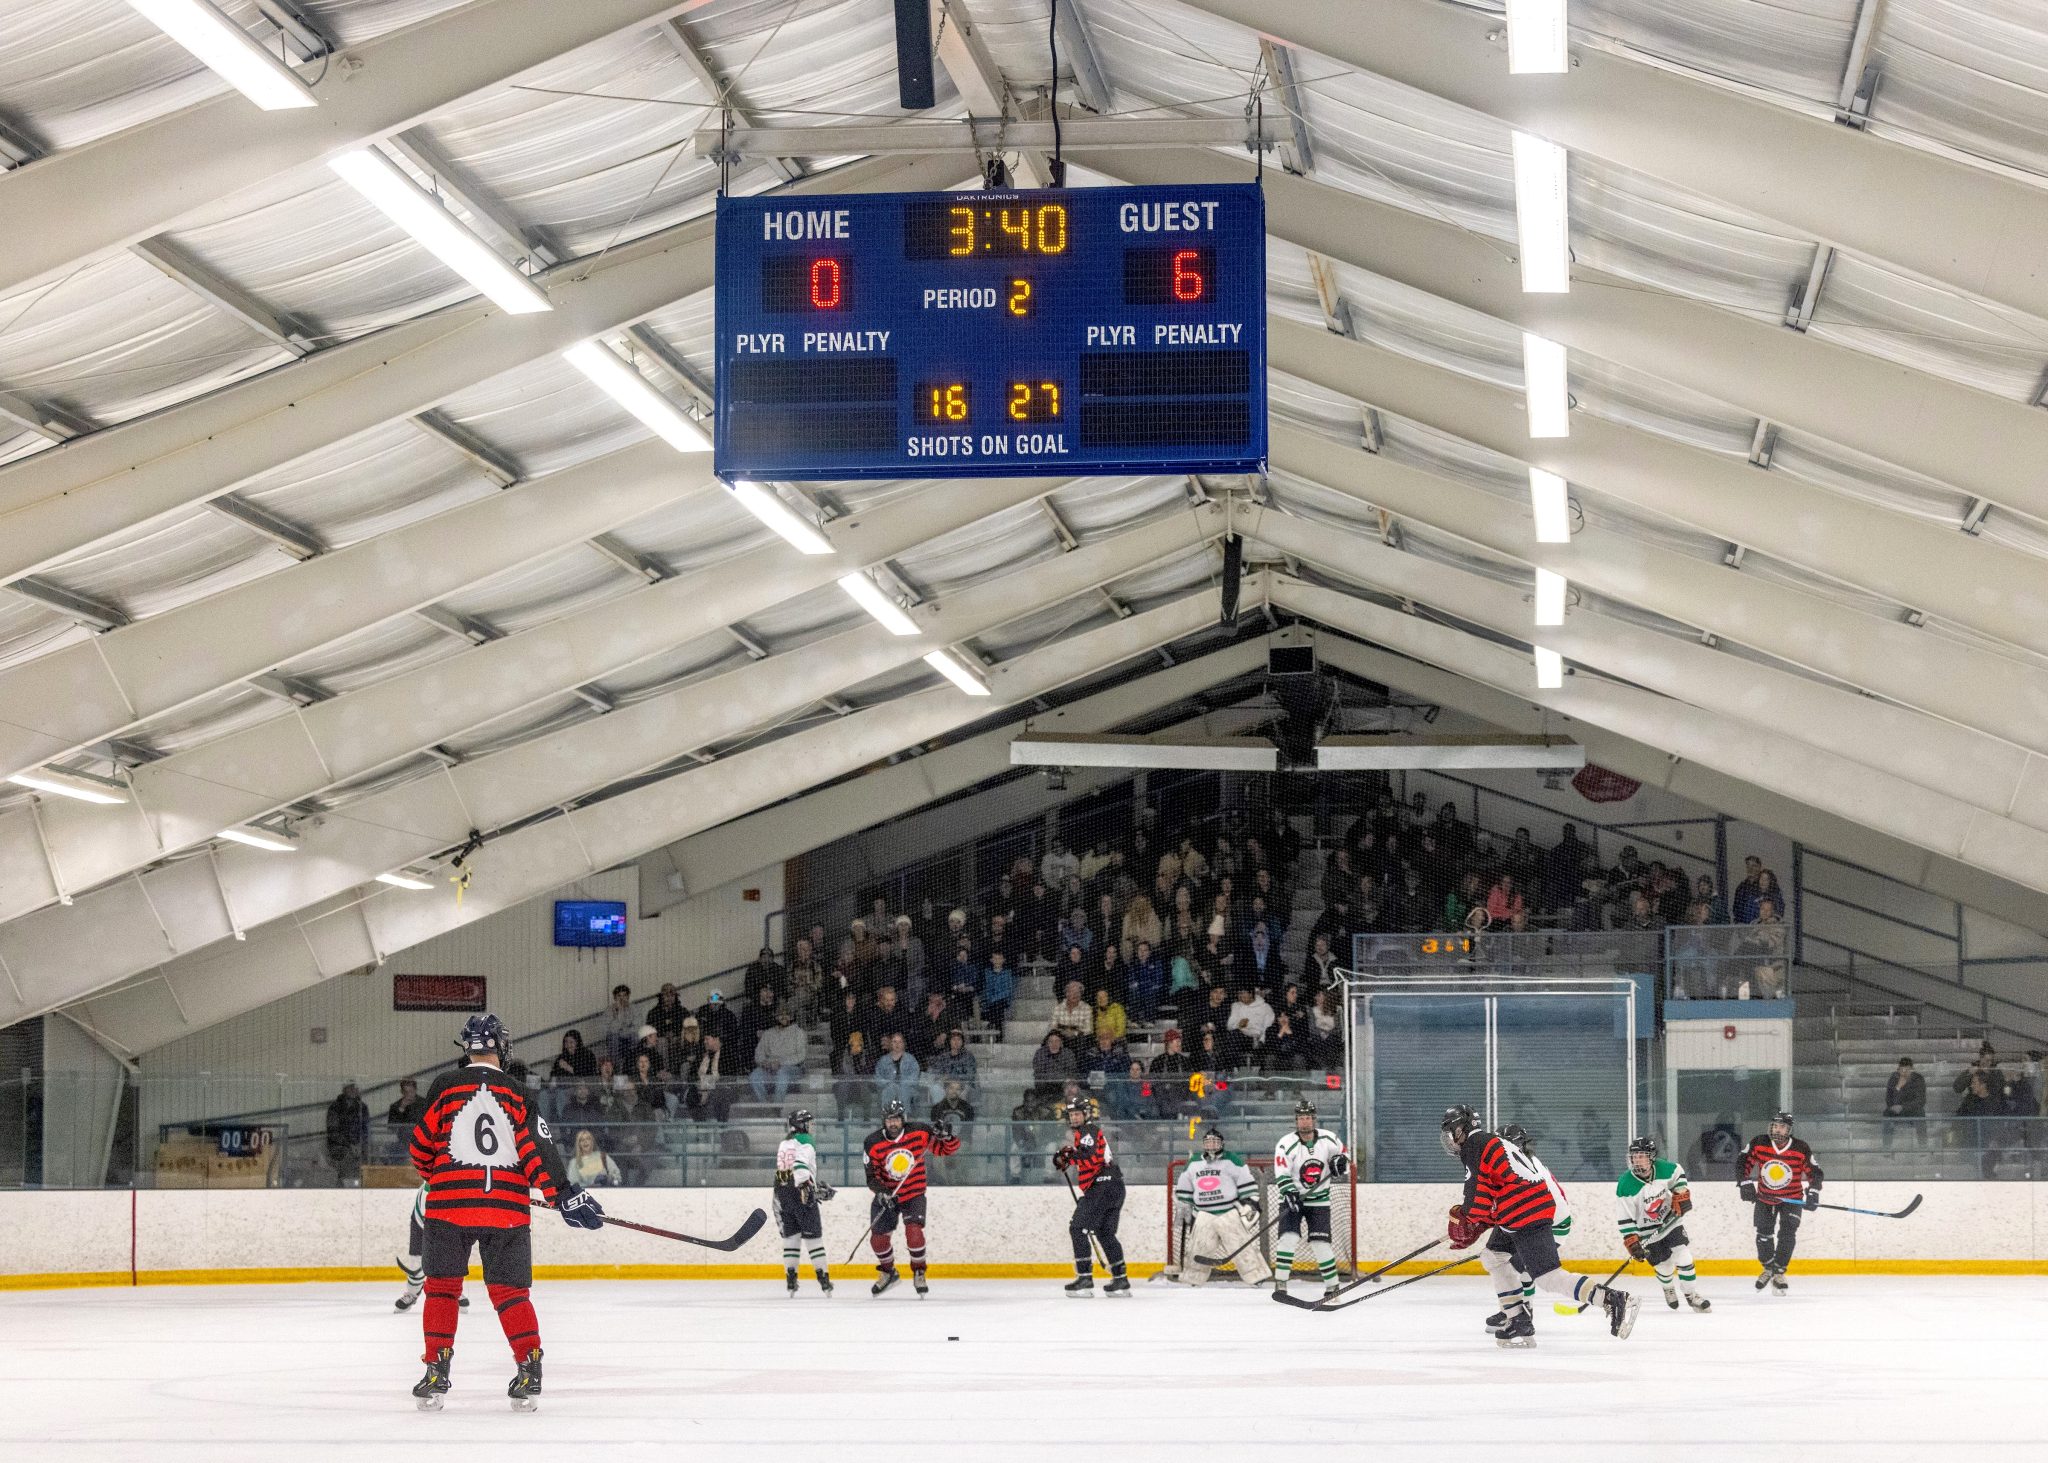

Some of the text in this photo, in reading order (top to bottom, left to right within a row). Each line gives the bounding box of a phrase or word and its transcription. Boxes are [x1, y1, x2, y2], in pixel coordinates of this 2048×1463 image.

[764, 210, 850, 241] HOME
[951, 205, 1066, 255] 3:40
[1120, 201, 1219, 233] GUEST
[810, 257, 841, 309] 0
[1173, 251, 1202, 300] 6
[924, 287, 997, 310] PERIOD
[1009, 280, 1031, 315] 2
[736, 331, 890, 354] PLYR PENALTY
[1087, 323, 1243, 346] PLYR PENALTY
[932, 385, 967, 420] 16
[1008, 383, 1059, 420] 27
[907, 434, 1069, 457] SHOTS ON GOAL
[474, 1112, 499, 1156] 6
[540, 1122, 550, 1136] 6
[1196, 1169, 1221, 1177] ASPEN
